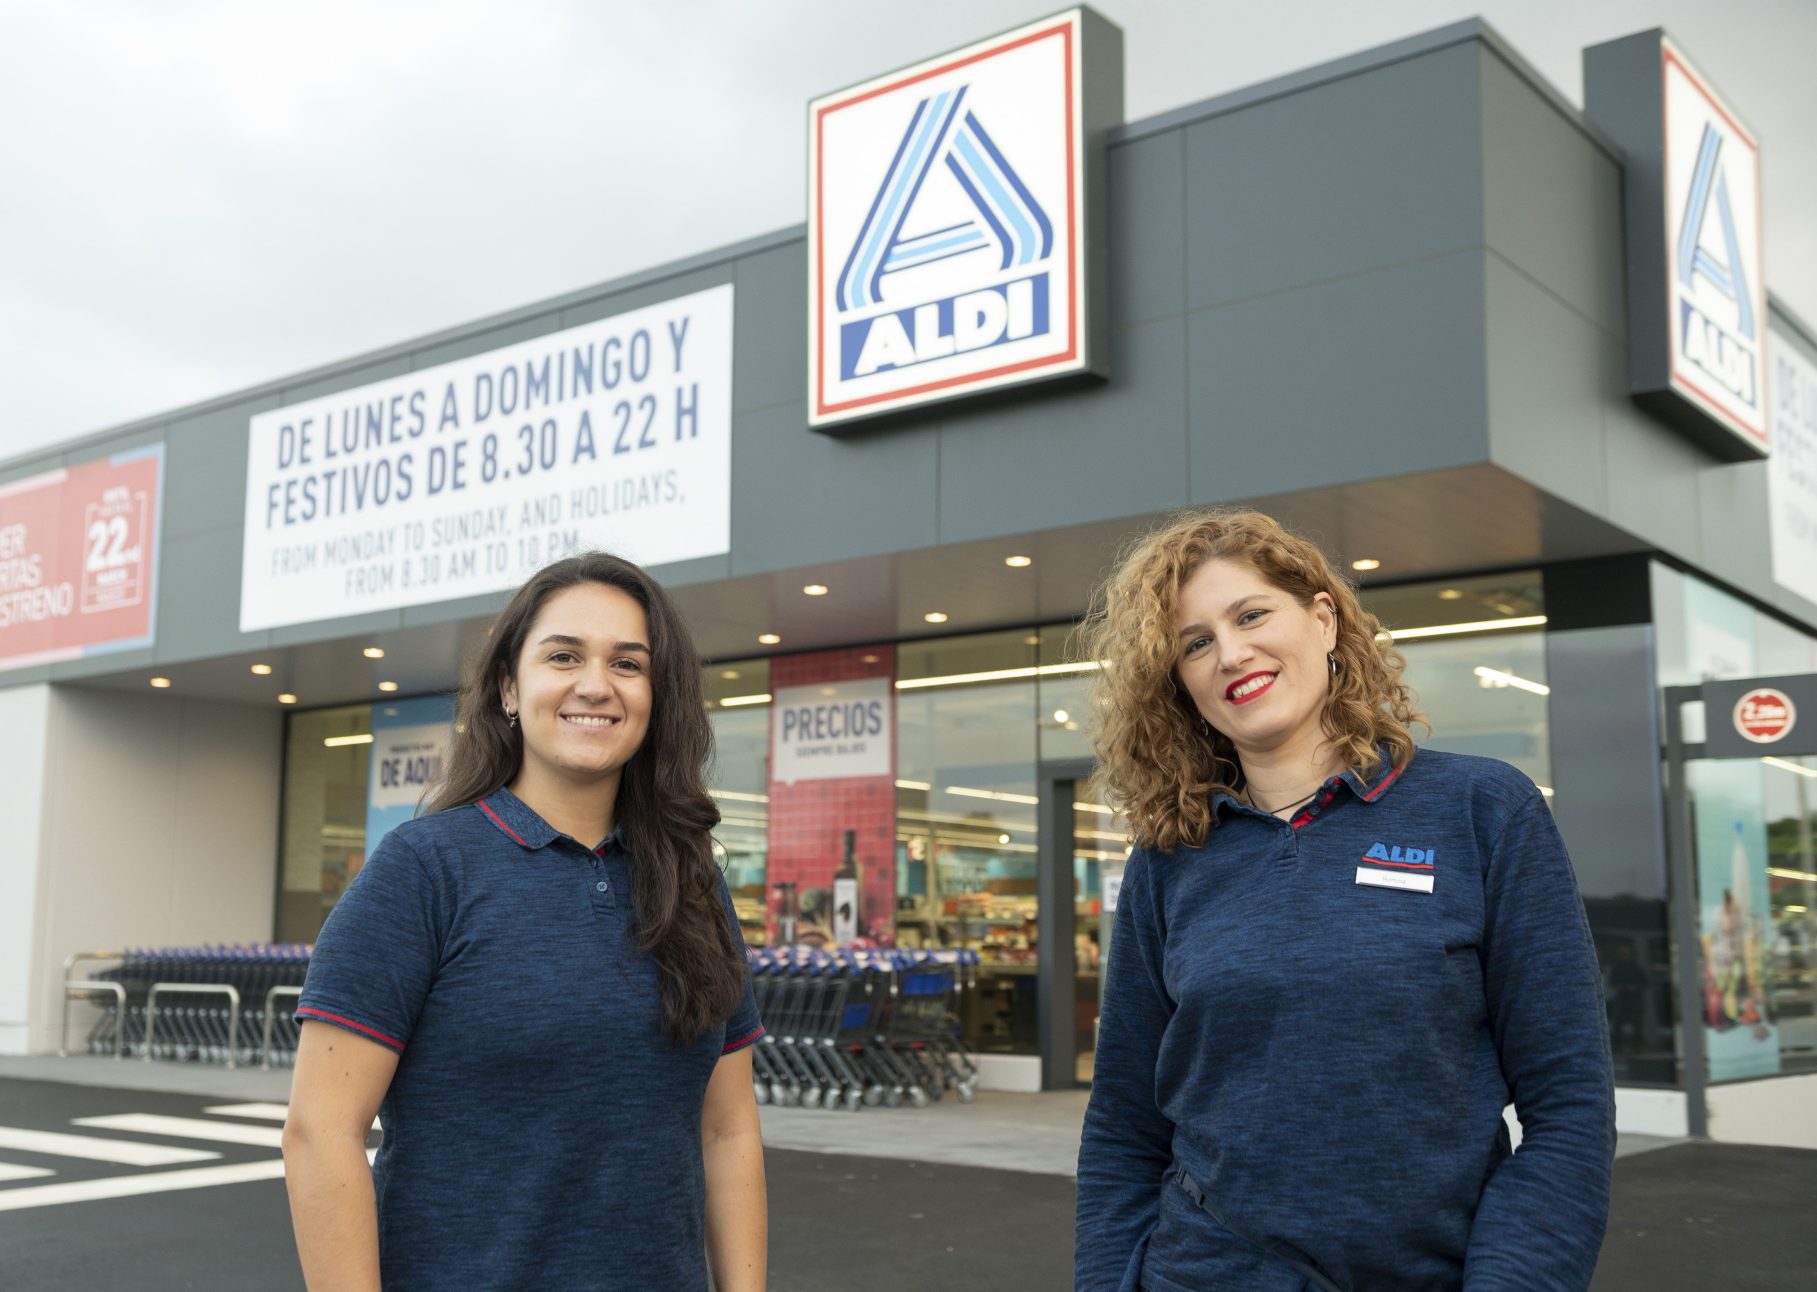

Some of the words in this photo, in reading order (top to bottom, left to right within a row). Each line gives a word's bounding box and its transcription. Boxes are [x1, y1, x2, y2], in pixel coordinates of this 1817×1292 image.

[853, 278, 1033, 376] ALDI
[1683, 306, 1754, 409] ALDI
[278, 419, 314, 469] DE
[325, 391, 426, 459] LUNES
[438, 382, 460, 431] A
[473, 328, 651, 424] DOMINGO
[668, 316, 690, 372] Y
[266, 453, 414, 529] FESTIVOS
[427, 441, 468, 495] DE
[480, 418, 557, 484] 8.30
[571, 411, 597, 464] A
[613, 395, 658, 455] 22
[674, 383, 699, 441] H
[86, 516, 129, 572] 22
[272, 547, 317, 577] FROM
[324, 527, 397, 569] MONDAY
[403, 521, 427, 553] TO
[431, 506, 512, 546] SUNDAY,
[519, 492, 563, 532] AND
[569, 470, 686, 519] HOLIDAYS,
[345, 566, 394, 598] FROM
[400, 557, 441, 588] 8.30
[447, 550, 477, 577] AM
[484, 542, 508, 573] TO
[517, 536, 539, 567] 10
[547, 529, 579, 561] PM
[783, 701, 882, 741] PRECIOS
[382, 760, 399, 787] DE
[1365, 842, 1435, 866] ALDI
